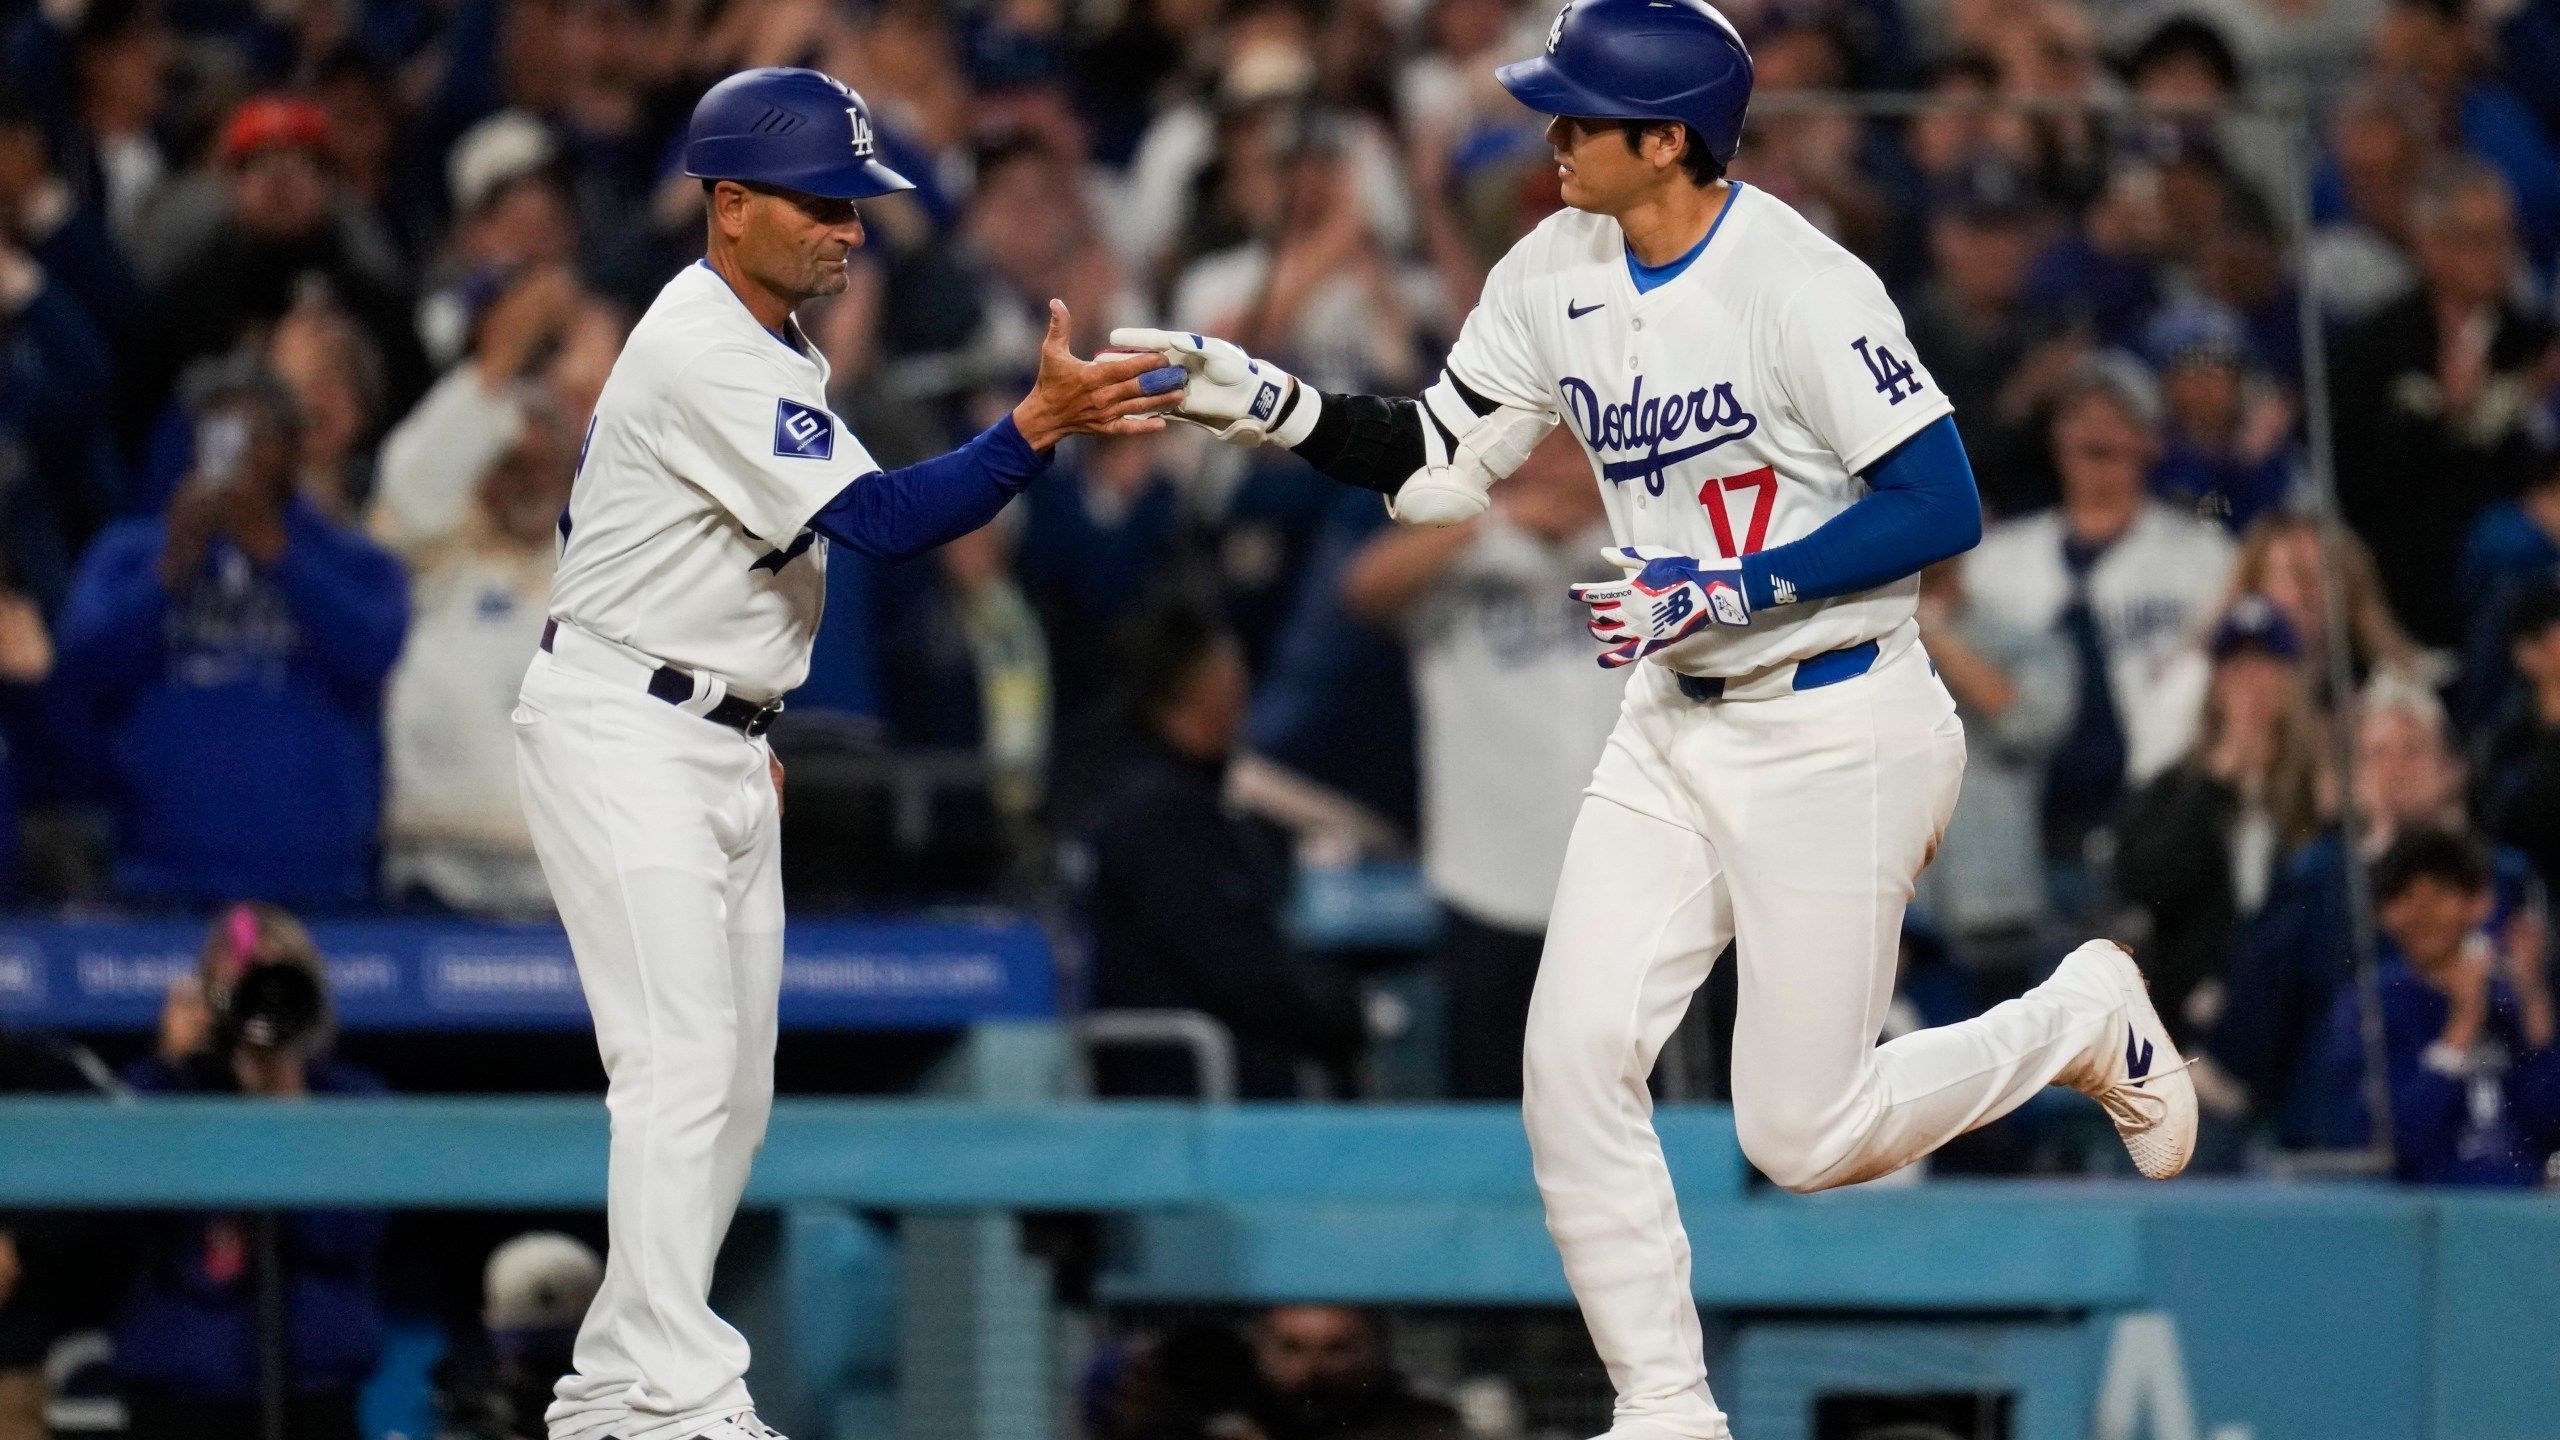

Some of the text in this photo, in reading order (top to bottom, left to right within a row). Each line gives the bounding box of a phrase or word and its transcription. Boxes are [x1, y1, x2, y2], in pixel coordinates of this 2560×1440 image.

[845, 107, 875, 156] LA
[1850, 335, 1924, 406] LA
[785, 409, 819, 441] G
[1558, 374, 1758, 497] Dodgers
[1697, 464, 1779, 559] 17
[1600, 589, 1632, 600] balance
